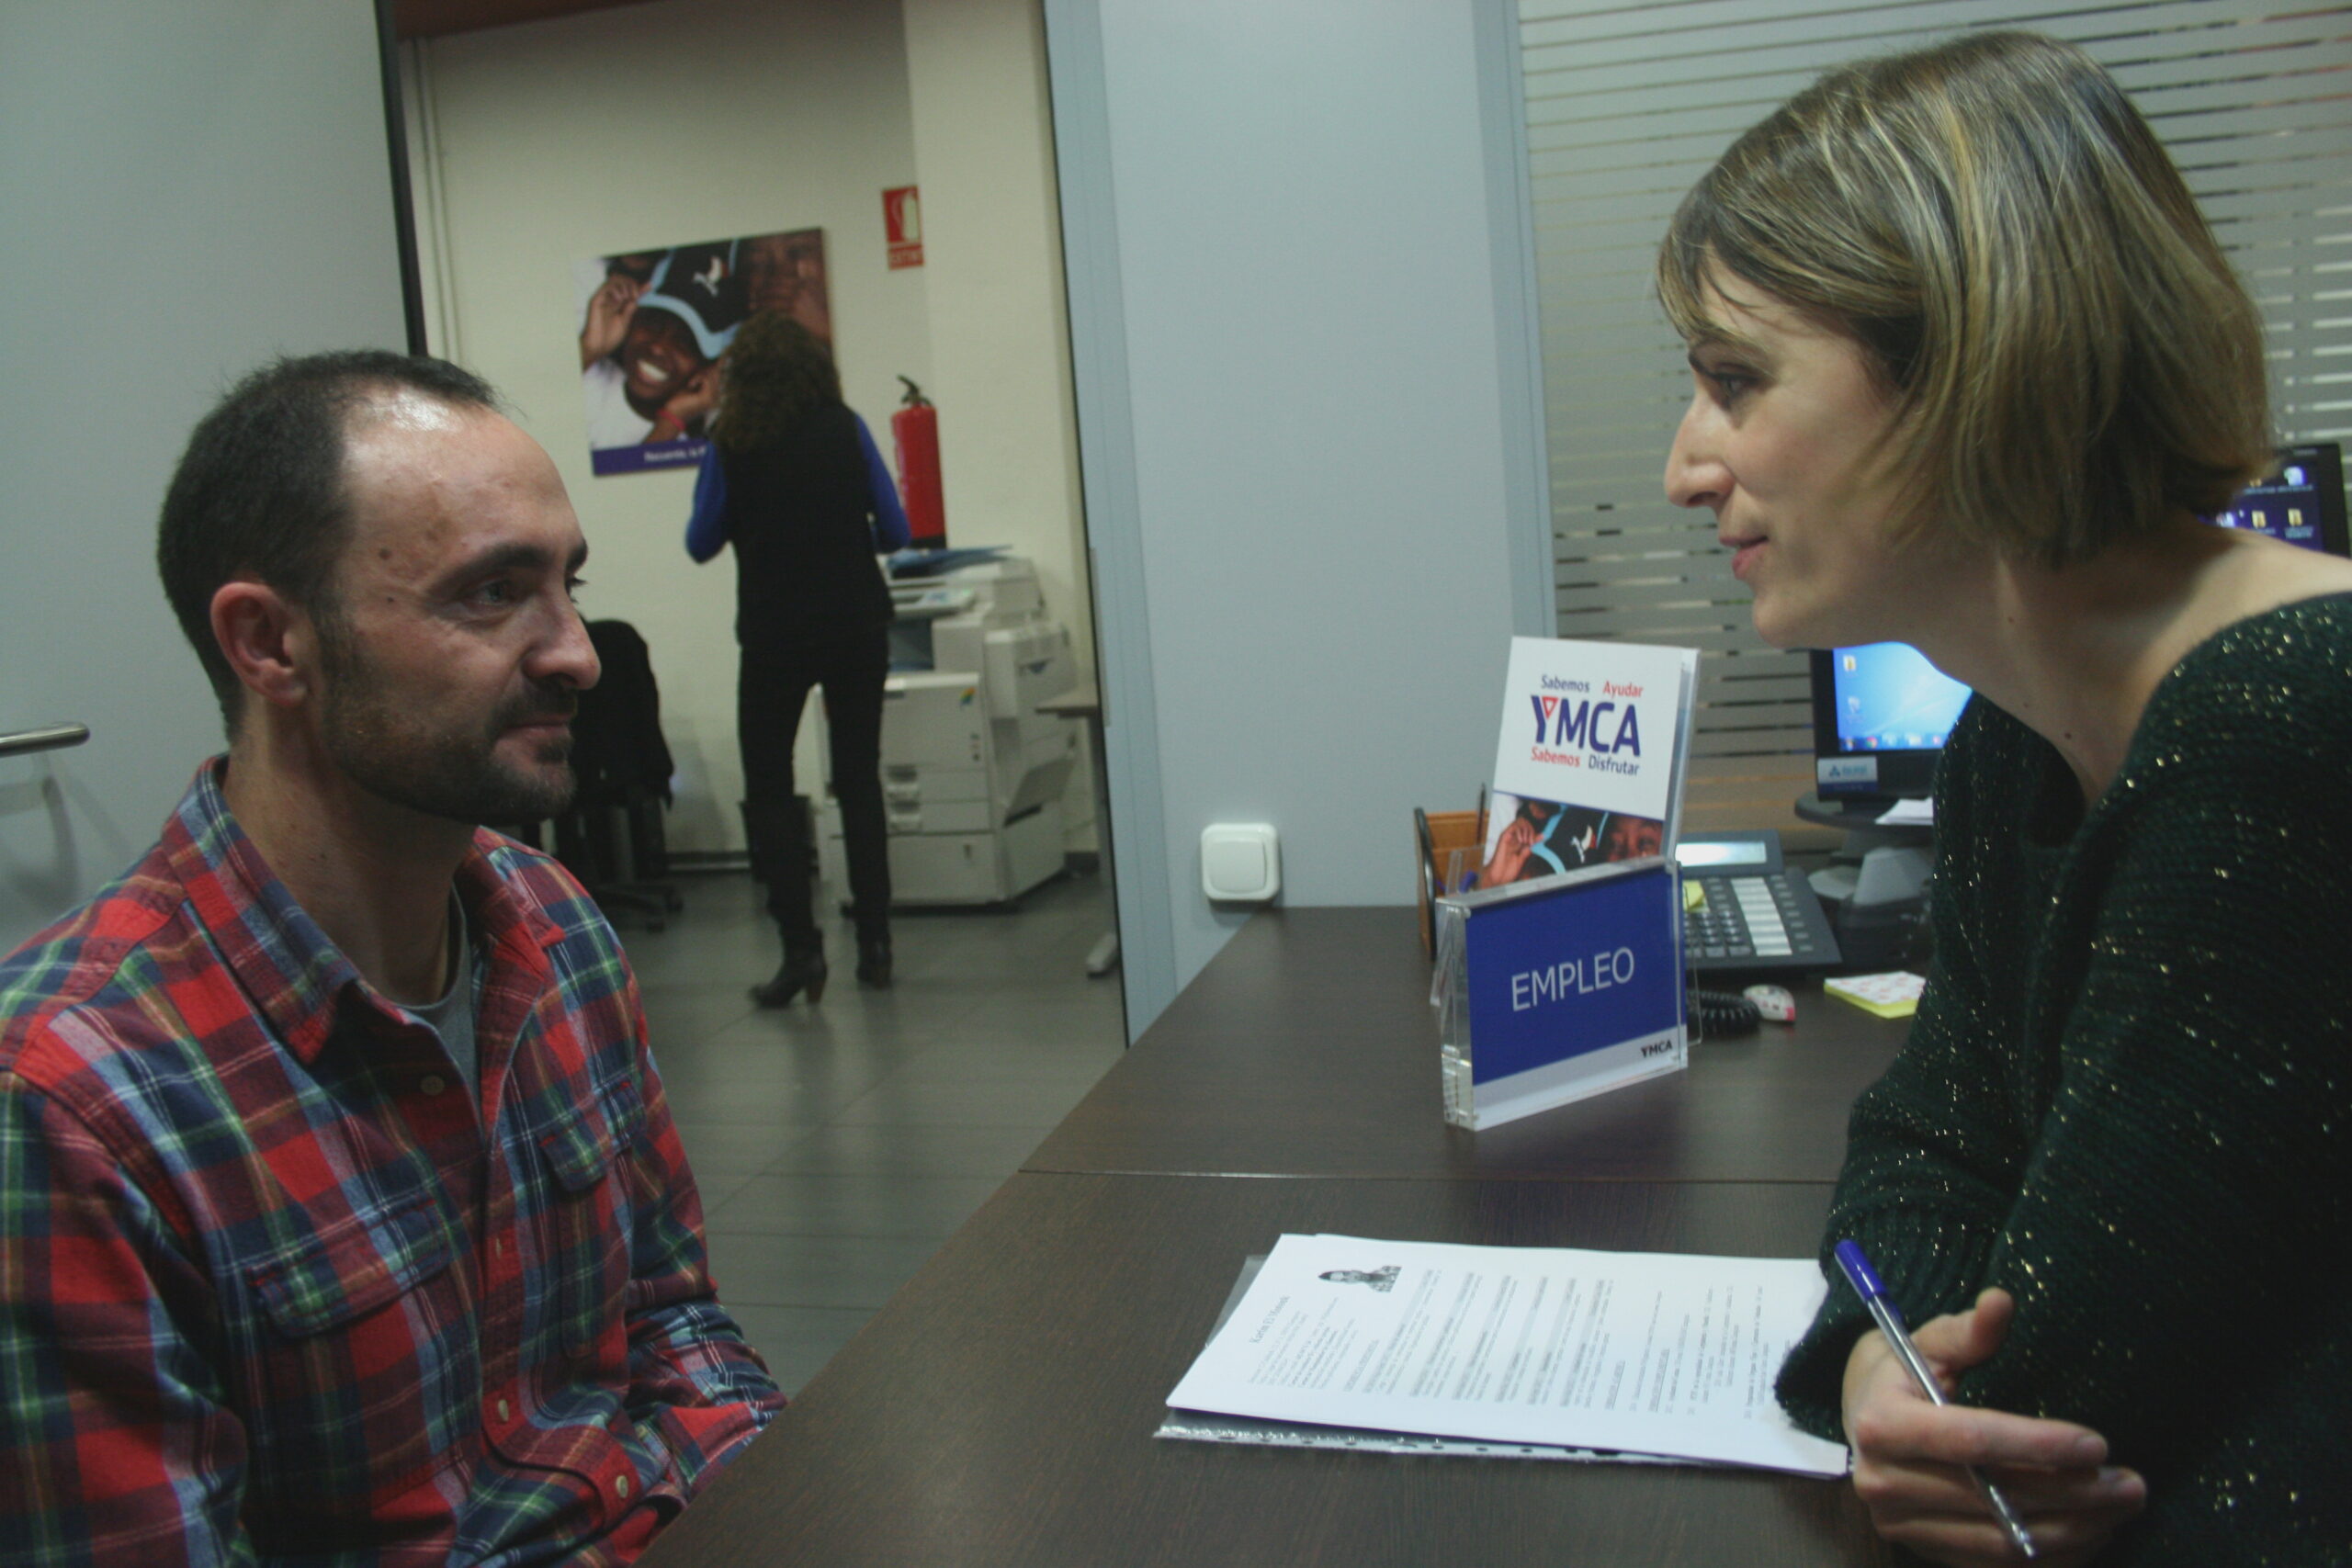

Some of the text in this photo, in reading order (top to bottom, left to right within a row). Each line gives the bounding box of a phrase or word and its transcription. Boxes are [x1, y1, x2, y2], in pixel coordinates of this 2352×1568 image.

[1541, 674, 1644, 699] Sabemos Ayudar
[1531, 694, 1641, 757] YMCA
[1531, 747, 1640, 775] Sabemos Disfrutar
[1511, 946, 1635, 1011] EMPLEO
[1640, 1039, 1673, 1058] YMCA
